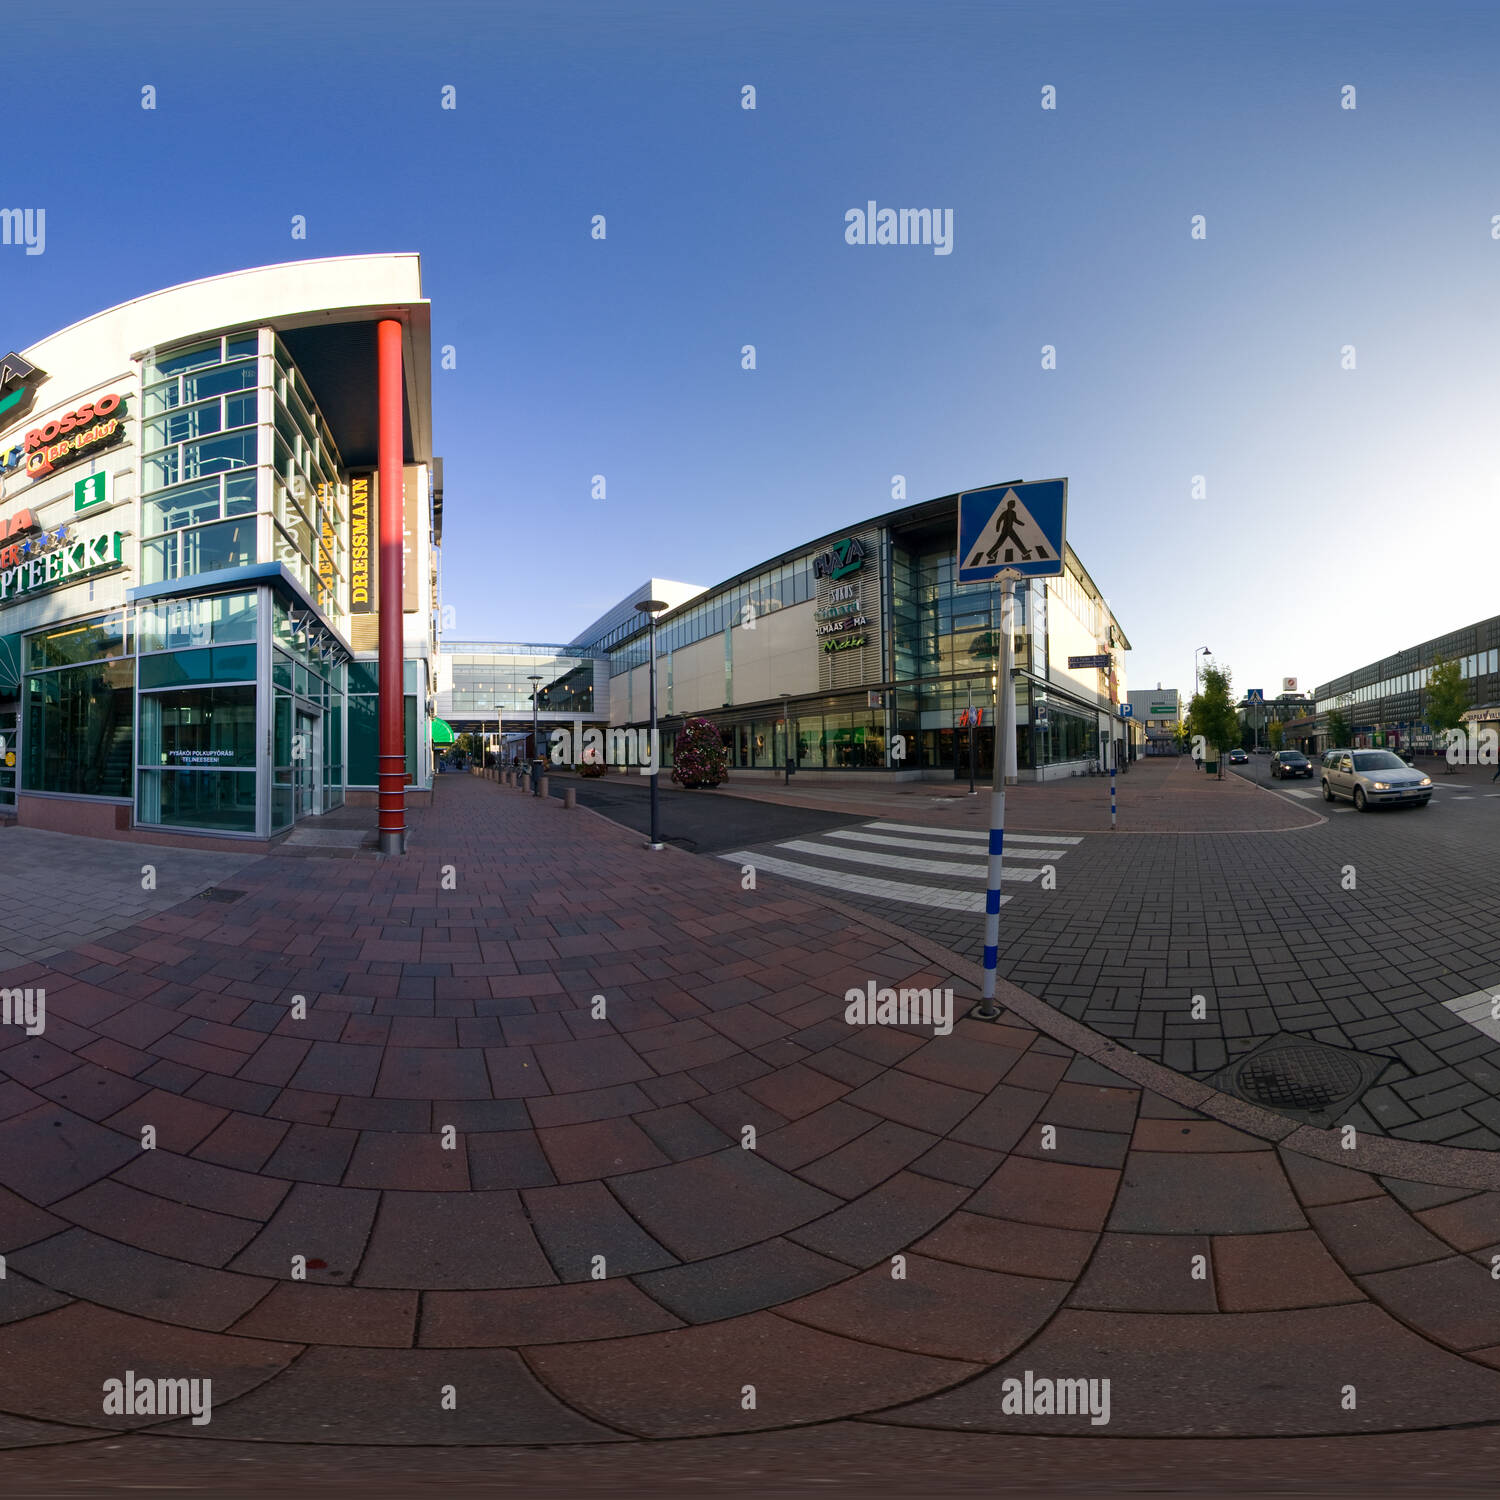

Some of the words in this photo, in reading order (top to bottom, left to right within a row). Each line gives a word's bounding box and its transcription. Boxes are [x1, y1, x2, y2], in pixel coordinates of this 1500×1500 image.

[24, 393, 121, 454] ROSSO
[352, 478, 368, 604] DRESSMANN
[1122, 704, 1131, 717] P
